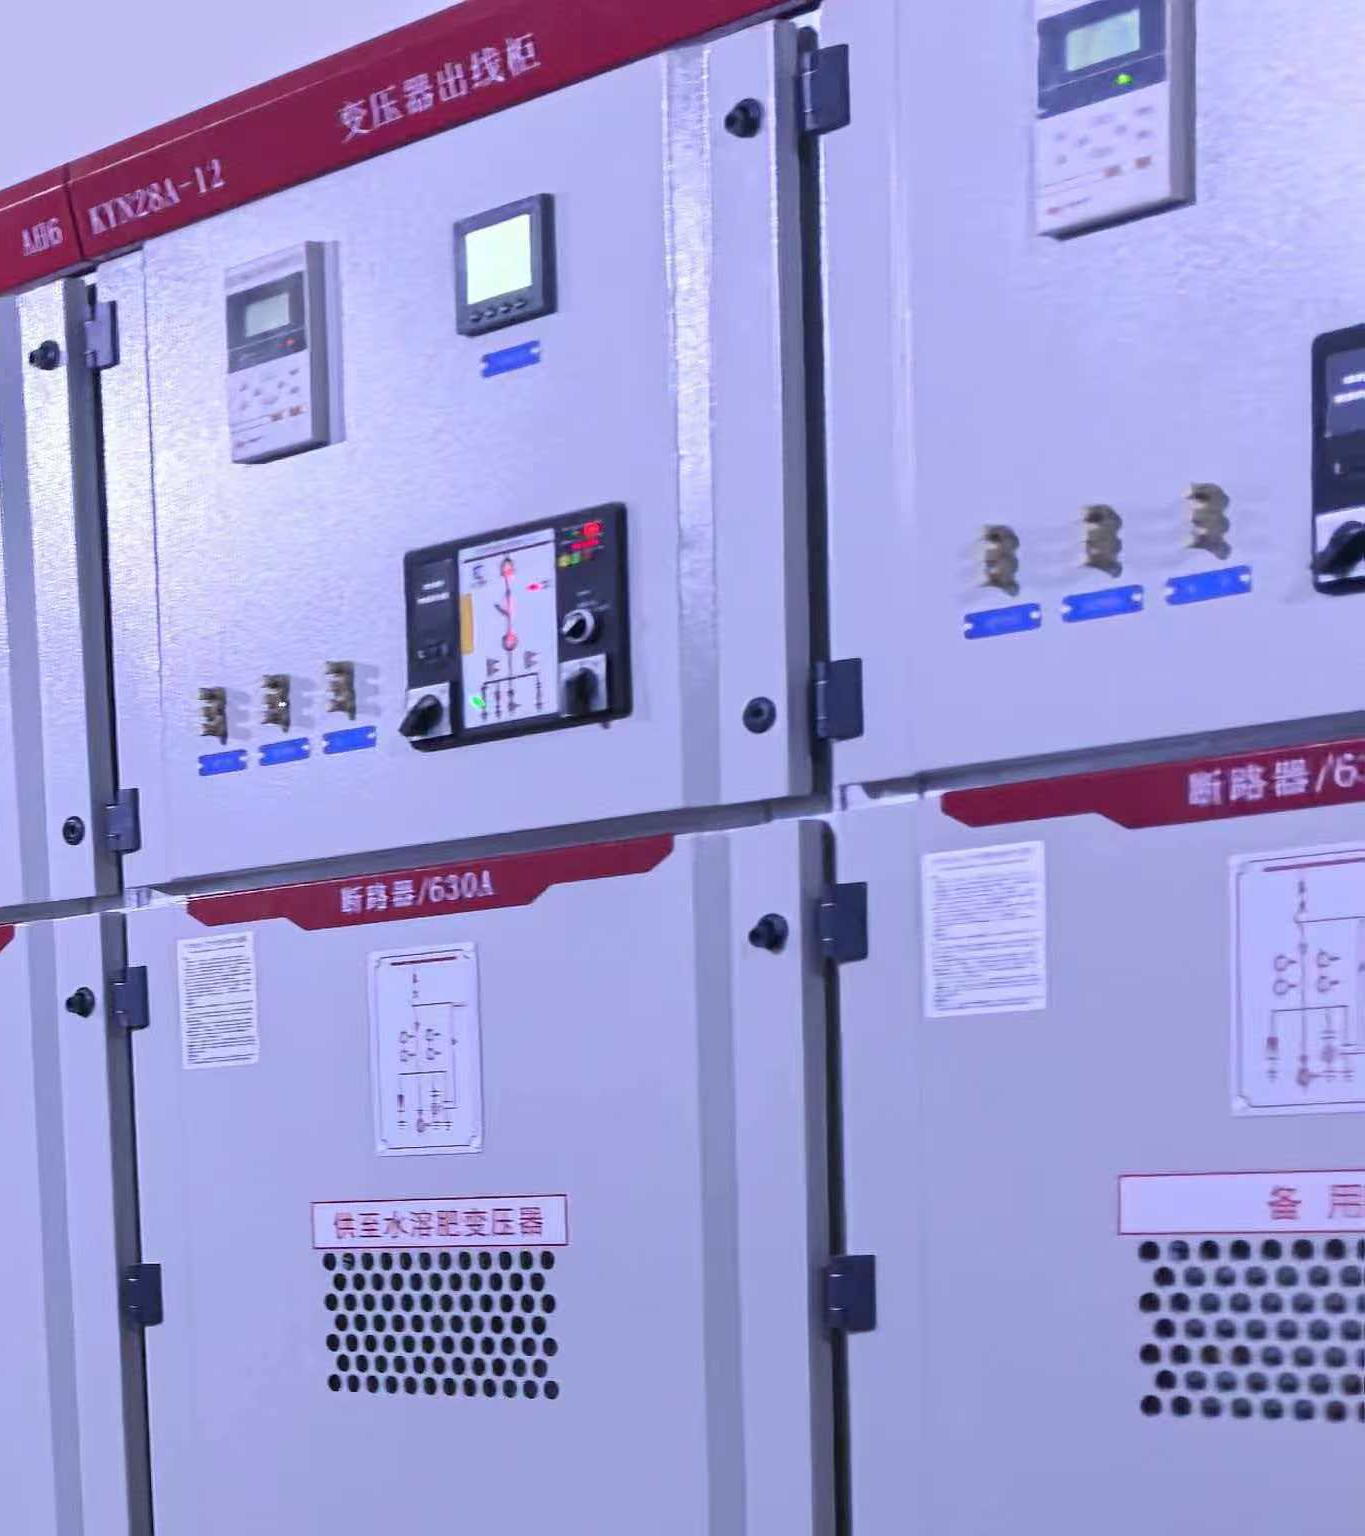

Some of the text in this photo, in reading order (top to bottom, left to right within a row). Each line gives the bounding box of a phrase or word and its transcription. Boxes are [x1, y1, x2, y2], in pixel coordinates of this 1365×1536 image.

[336, 32, 542, 143] 变压器出线柜
[1188, 751, 1365, 806] 断路器/6
[340, 869, 495, 914] 断路器/630A
[333, 1206, 545, 1240] 供至水溶肥变压器
